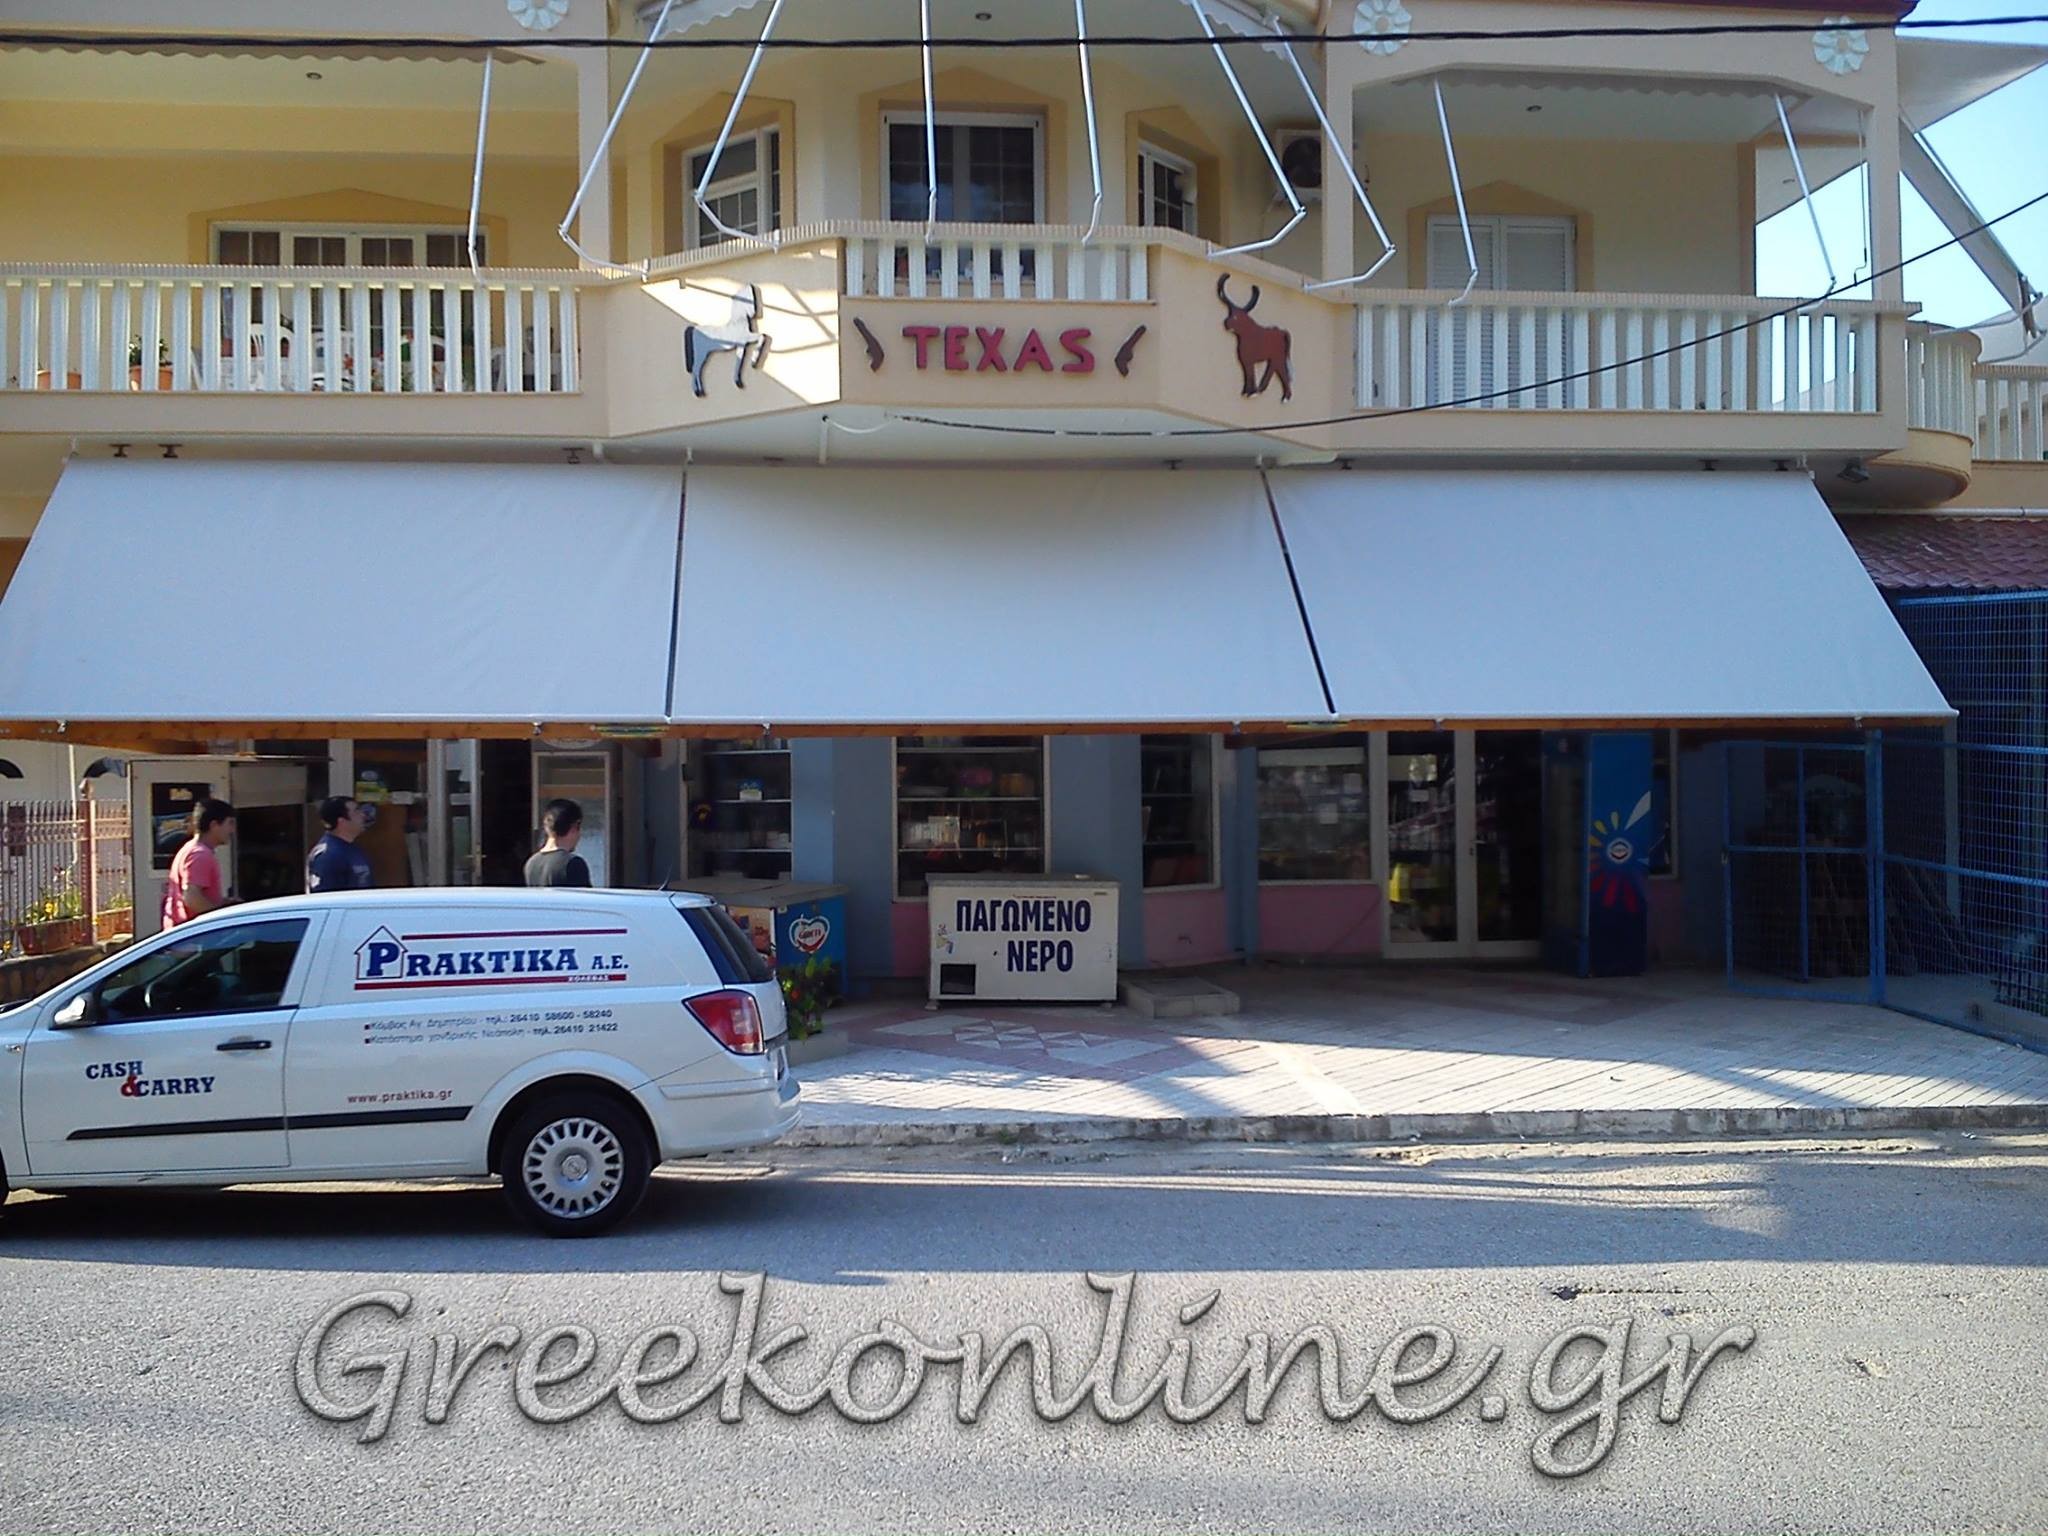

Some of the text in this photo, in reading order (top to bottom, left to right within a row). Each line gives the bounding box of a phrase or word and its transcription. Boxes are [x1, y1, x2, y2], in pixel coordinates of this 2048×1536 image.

[902, 326, 1096, 373] TEXAS
[956, 899, 1092, 933] ΠΑΓΩΜΕΝΟ
[366, 941, 629, 977] PRAKTIKA A.E.
[1007, 939, 1074, 973] ΝΕΡΟ
[85, 1060, 143, 1080] CASH
[136, 1076, 216, 1098] CARRY
[347, 1089, 453, 1104] www.praktika.gr
